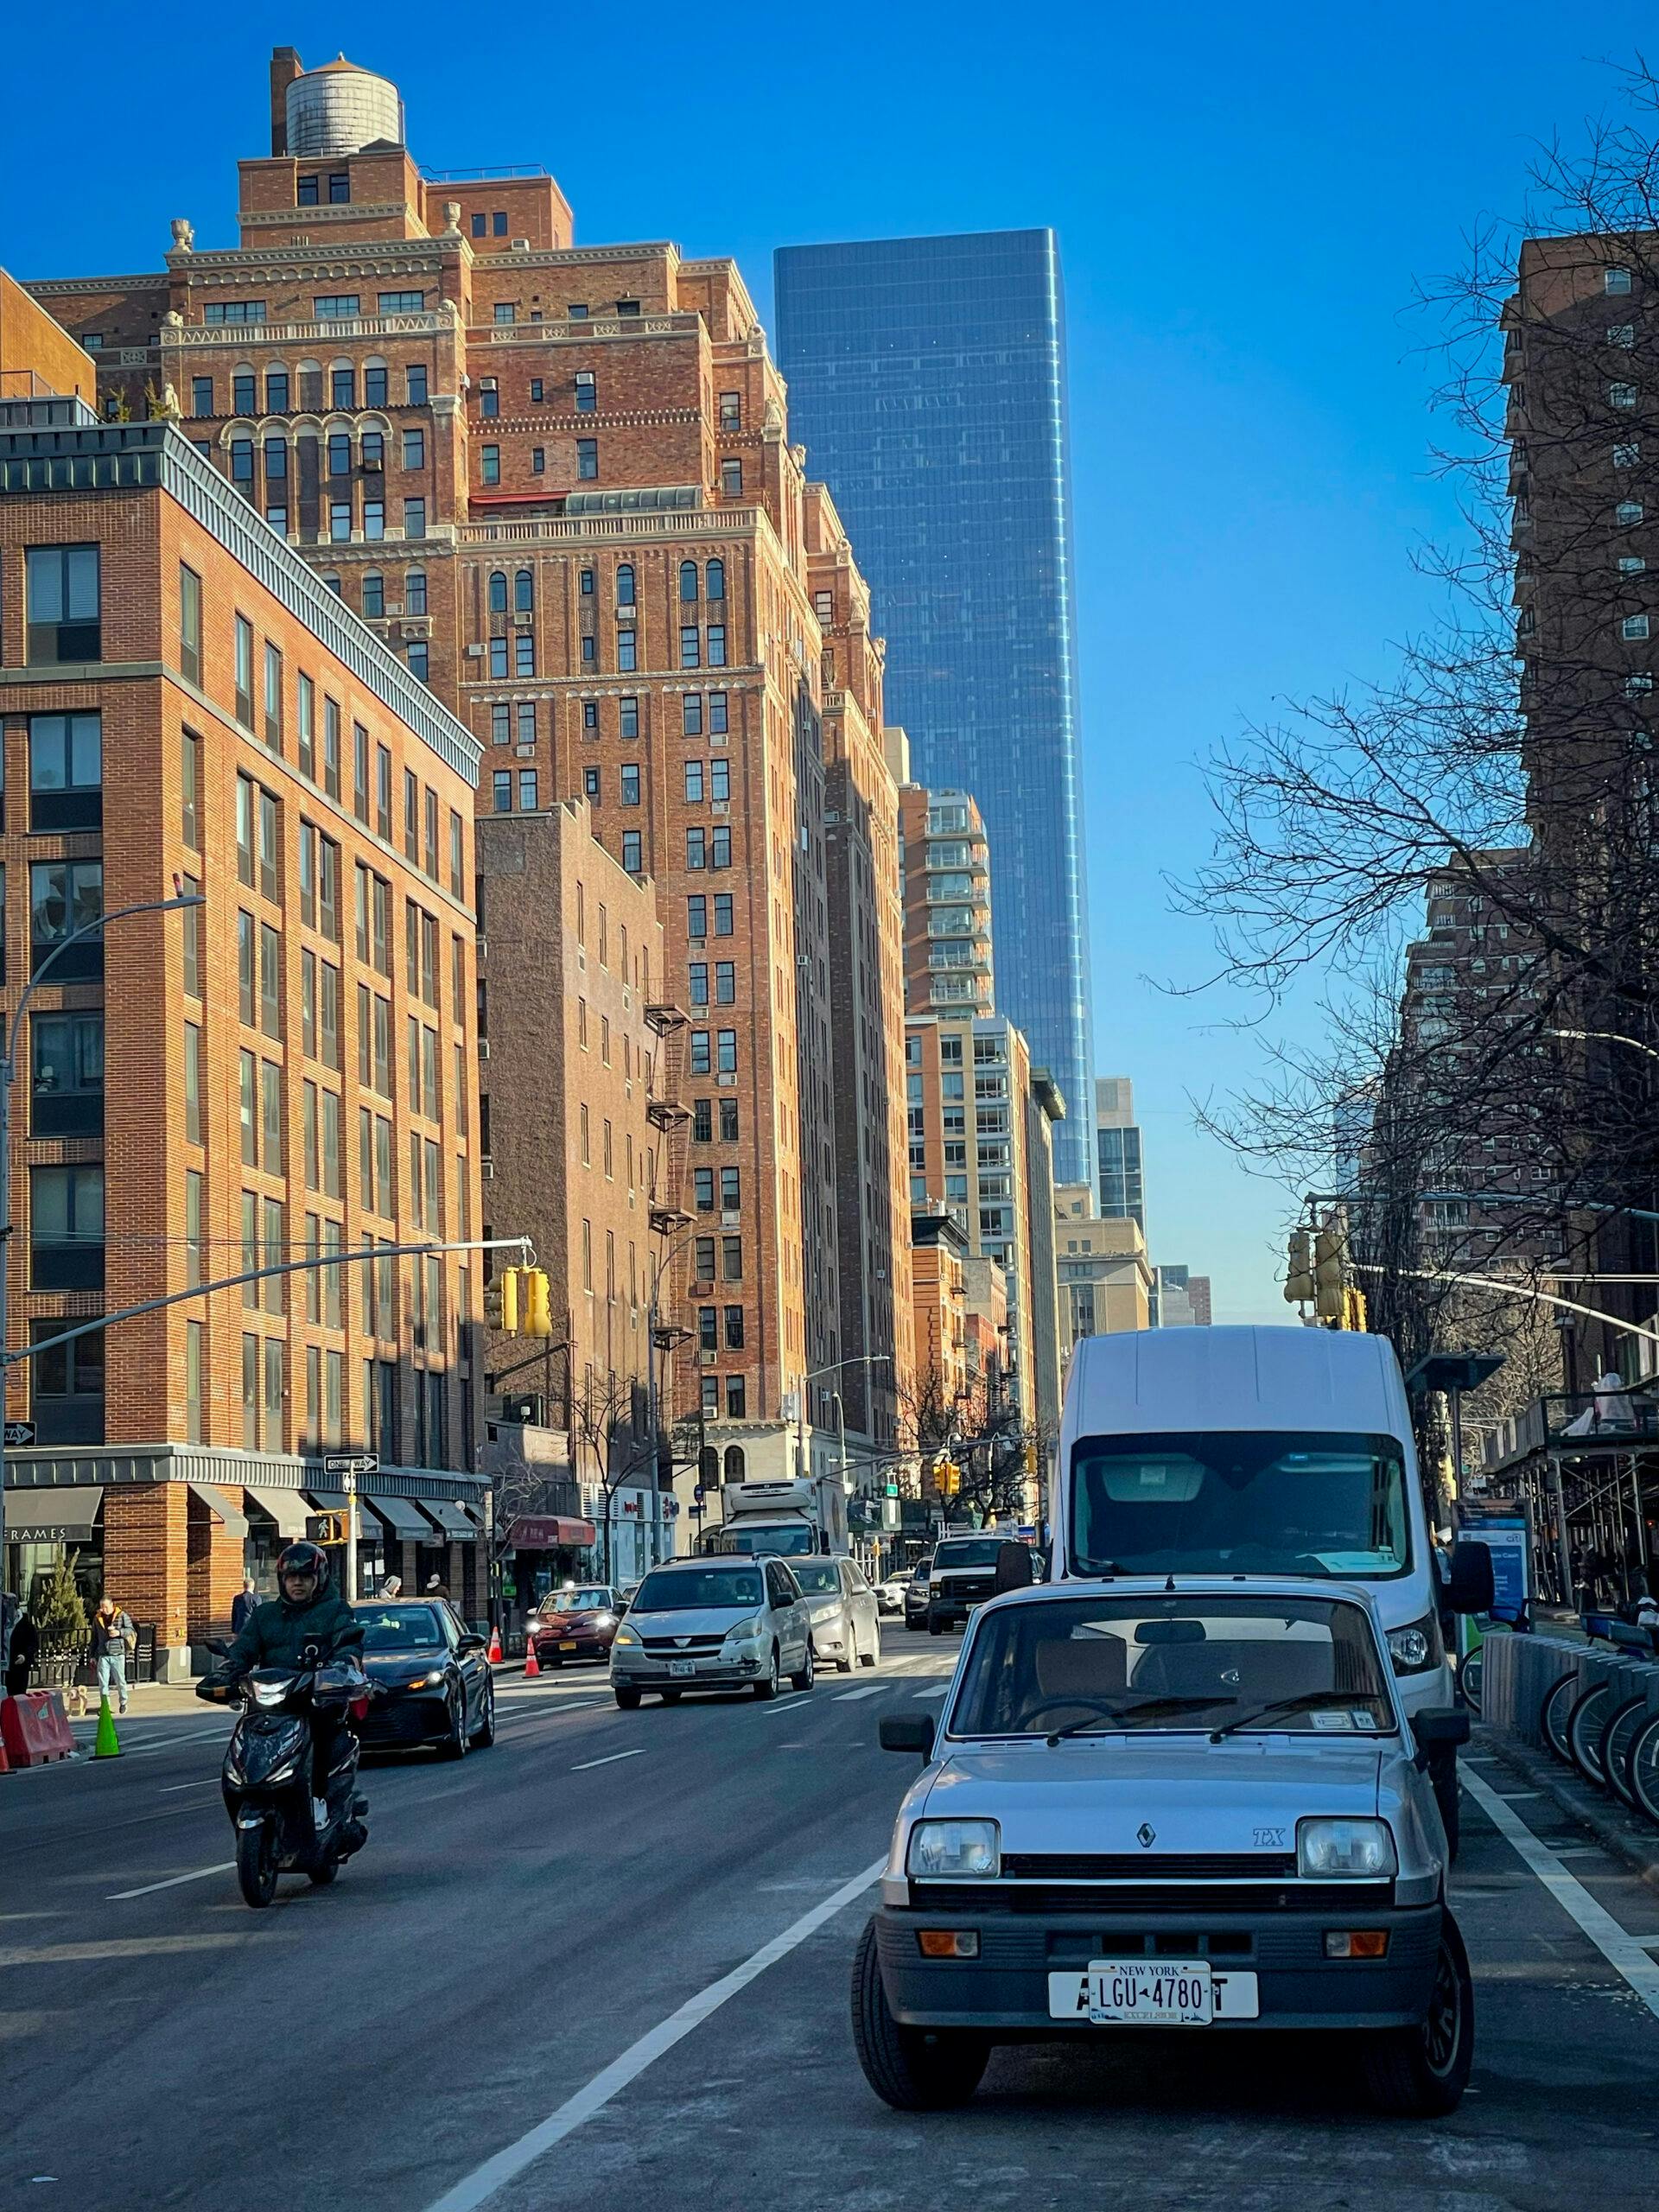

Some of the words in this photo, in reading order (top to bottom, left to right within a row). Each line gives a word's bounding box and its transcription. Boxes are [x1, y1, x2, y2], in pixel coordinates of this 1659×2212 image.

[4, 1528, 66, 1541] RAMES
[1253, 1827, 1286, 1847] TX
[1120, 1966, 1146, 1976] NEW
[1148, 1966, 1180, 1977] YORK
[1099, 1978, 1137, 2008] LGU
[1152, 1978, 1202, 2009] 4780
